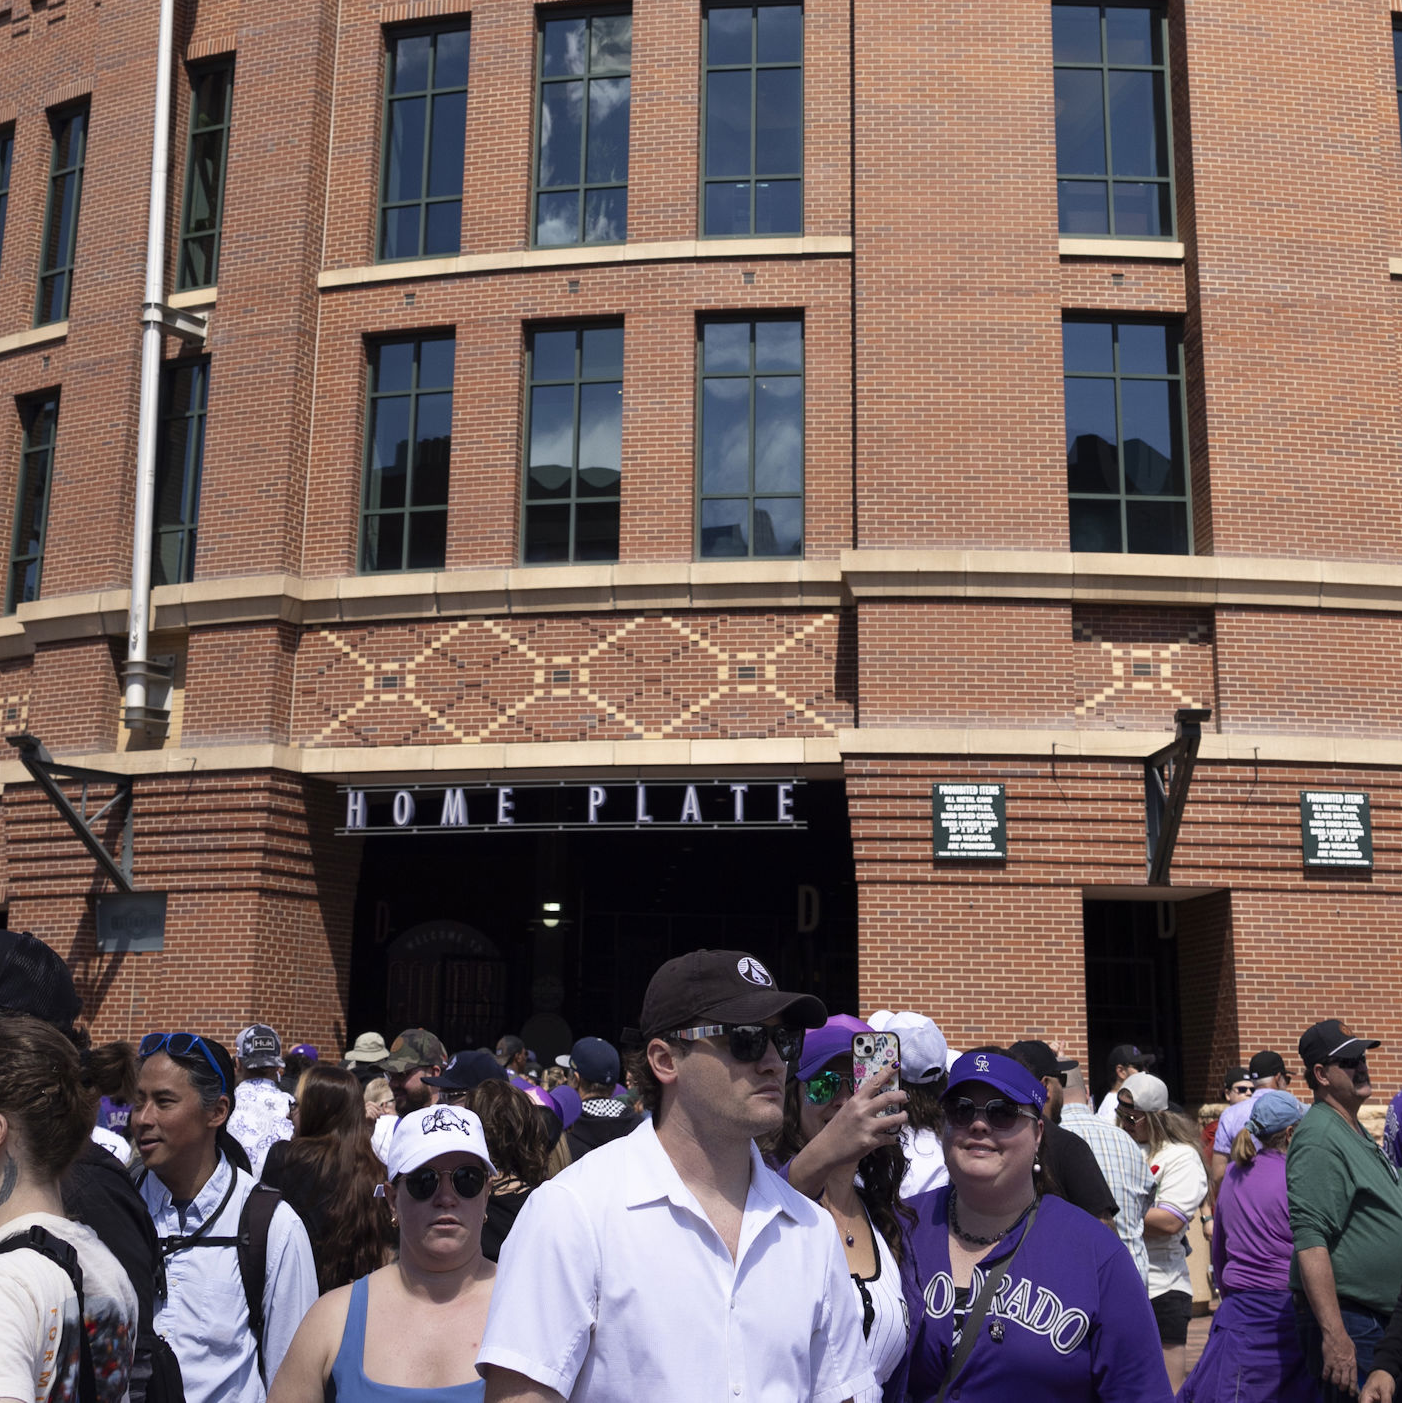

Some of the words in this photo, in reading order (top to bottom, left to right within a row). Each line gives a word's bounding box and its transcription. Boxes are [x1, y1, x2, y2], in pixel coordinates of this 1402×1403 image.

[346, 788, 515, 829] HOME
[589, 784, 795, 824] PLATE
[797, 884, 821, 934] D
[974, 1054, 990, 1072] CR
[36, 1308, 59, 1403] FORM
